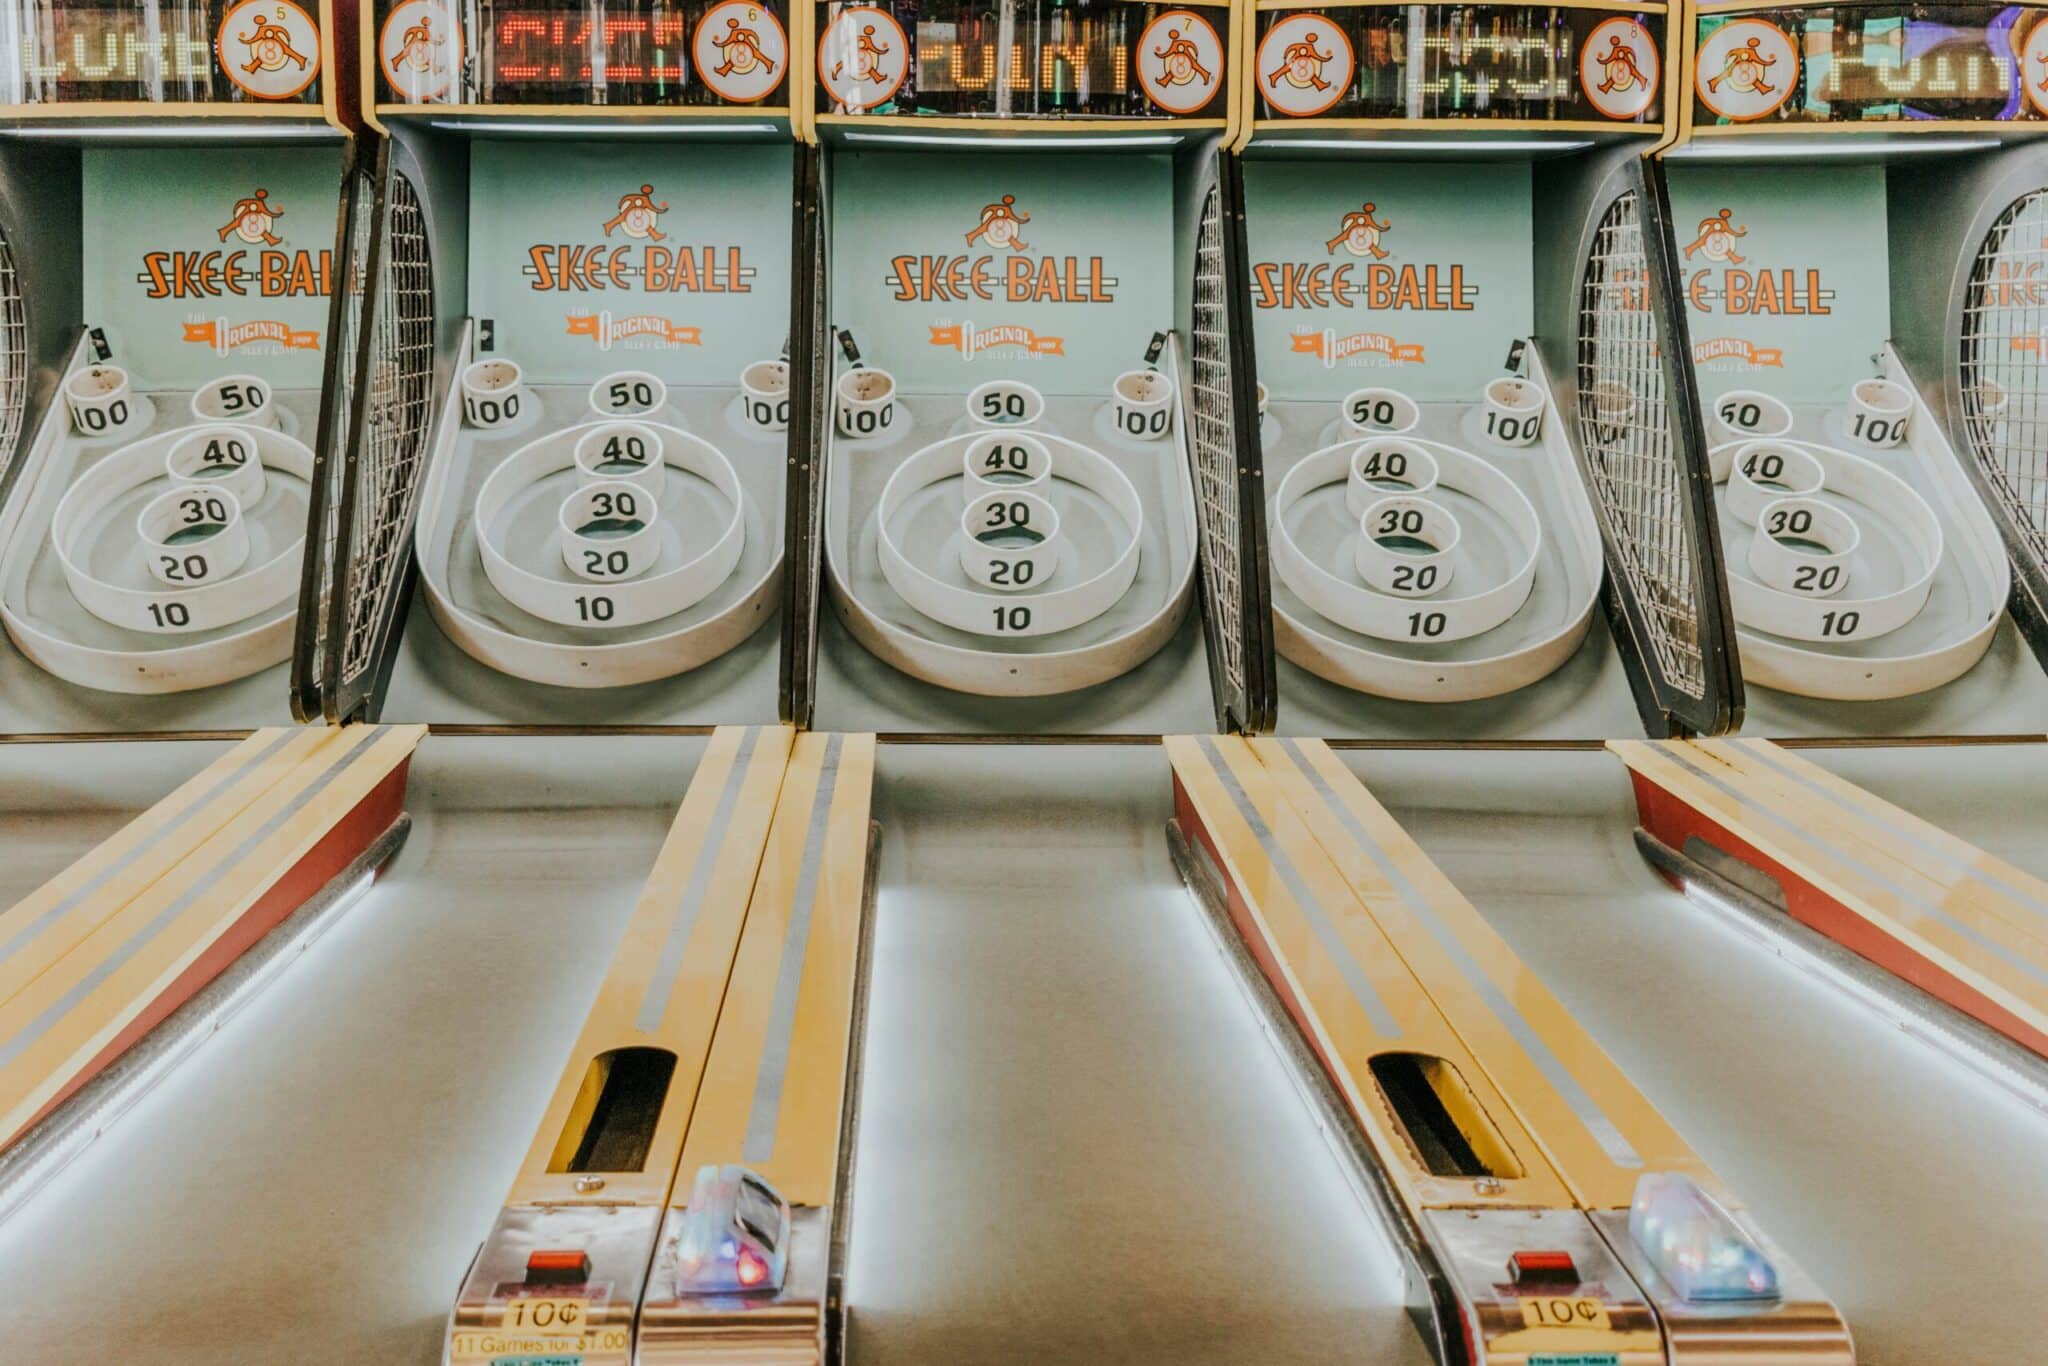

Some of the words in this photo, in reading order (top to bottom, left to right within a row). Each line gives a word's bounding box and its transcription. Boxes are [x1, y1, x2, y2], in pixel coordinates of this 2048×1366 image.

[276, 7, 286, 20] 5
[748, 8, 757, 21] 6
[1183, 18, 1192, 31] 7
[143, 250, 248, 298] SKEE
[528, 244, 632, 292] SKEE
[644, 245, 752, 293] BALL
[891, 255, 993, 302] SKEE
[1006, 256, 1115, 303] BALL
[1253, 263, 1354, 310] SKEE
[1367, 264, 1475, 311] BALL
[1724, 269, 1831, 315] BALL
[215, 315, 288, 359] ORIGINAL
[599, 310, 670, 351] ORIGINAL
[961, 319, 1032, 362] ORIGINAL
[1322, 327, 1393, 369] ORIGINAL
[1694, 339, 1752, 363] RIGINAL
[220, 385, 264, 410] 50
[609, 382, 653, 407] 50
[983, 392, 1026, 417] 50
[74, 399, 129, 431] 100
[467, 394, 520, 424] 100
[745, 396, 789, 425] 100
[843, 403, 893, 433] 100
[1116, 406, 1167, 435] 100
[1352, 400, 1394, 425] 50
[1720, 403, 1761, 427] 50
[1487, 412, 1538, 441] 100
[1853, 414, 1906, 443] 100
[203, 440, 247, 464] 40
[602, 436, 646, 460] 40
[985, 446, 1028, 470] 40
[1363, 453, 1407, 477] 40
[1742, 455, 1784, 479] 40
[180, 498, 227, 523] 30
[591, 492, 637, 517] 30
[985, 502, 1030, 527] 30
[1378, 509, 1423, 534] 30
[1767, 510, 1812, 535] 30
[160, 555, 208, 580] 20
[583, 550, 629, 576] 20
[989, 560, 1034, 585] 20
[1392, 566, 1437, 591] 20
[1793, 566, 1840, 591] 20
[148, 602, 190, 627] 10
[575, 597, 614, 622] 10
[993, 607, 1031, 631] 10
[1408, 612, 1446, 637] 10
[1821, 611, 1860, 636] 10
[511, 1301, 580, 1328] 10¢
[1528, 1299, 1598, 1324] 10¢
[454, 1338, 475, 1353] 11
[480, 1335, 545, 1353] Games
